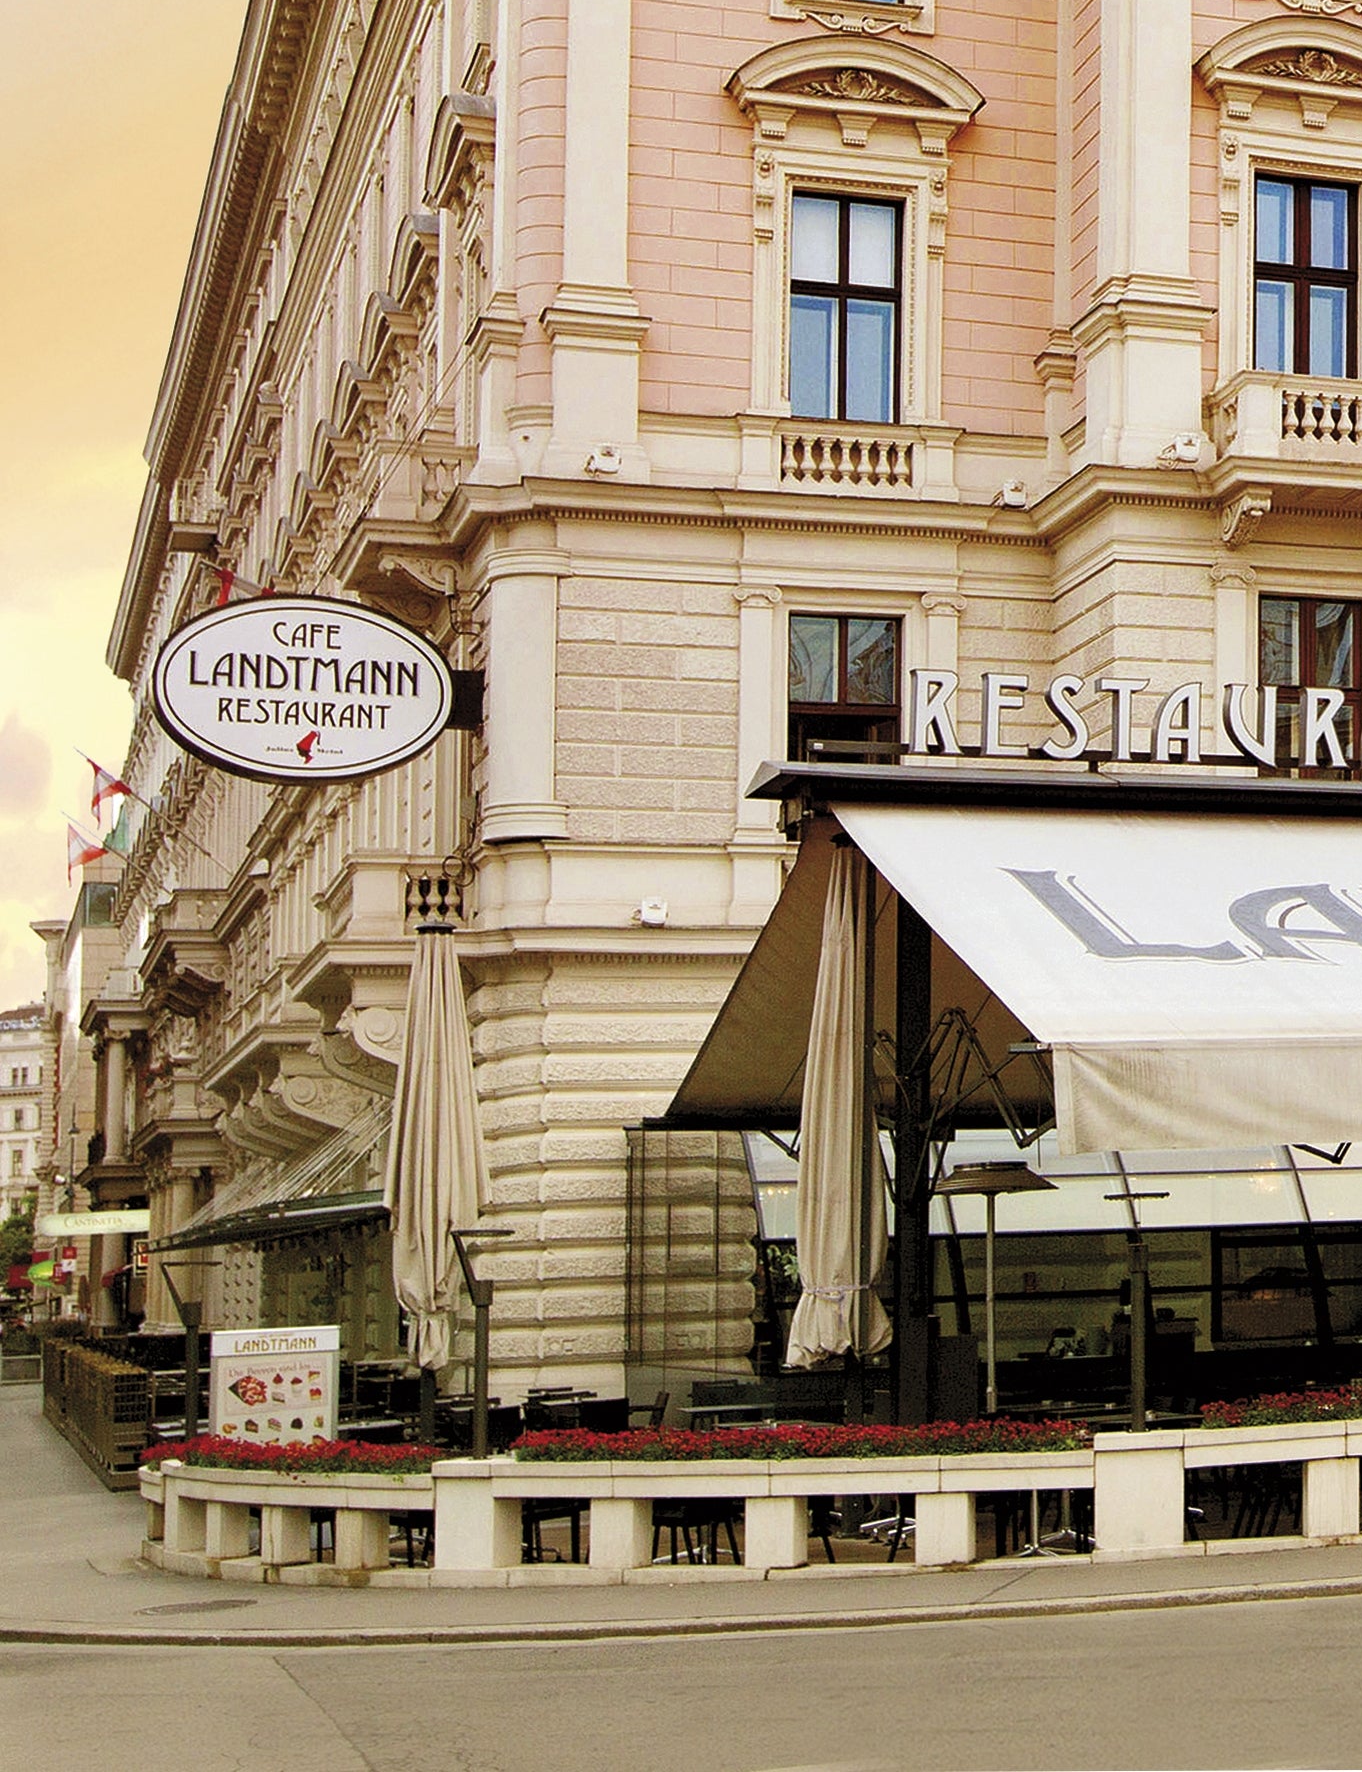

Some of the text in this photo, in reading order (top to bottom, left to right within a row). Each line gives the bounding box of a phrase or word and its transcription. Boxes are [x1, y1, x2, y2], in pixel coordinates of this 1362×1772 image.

[273, 621, 341, 650] CAFE
[189, 650, 419, 697] LANDTMANN
[218, 698, 391, 729] RESTAURANT
[234, 1337, 317, 1353] LANDTMANN
